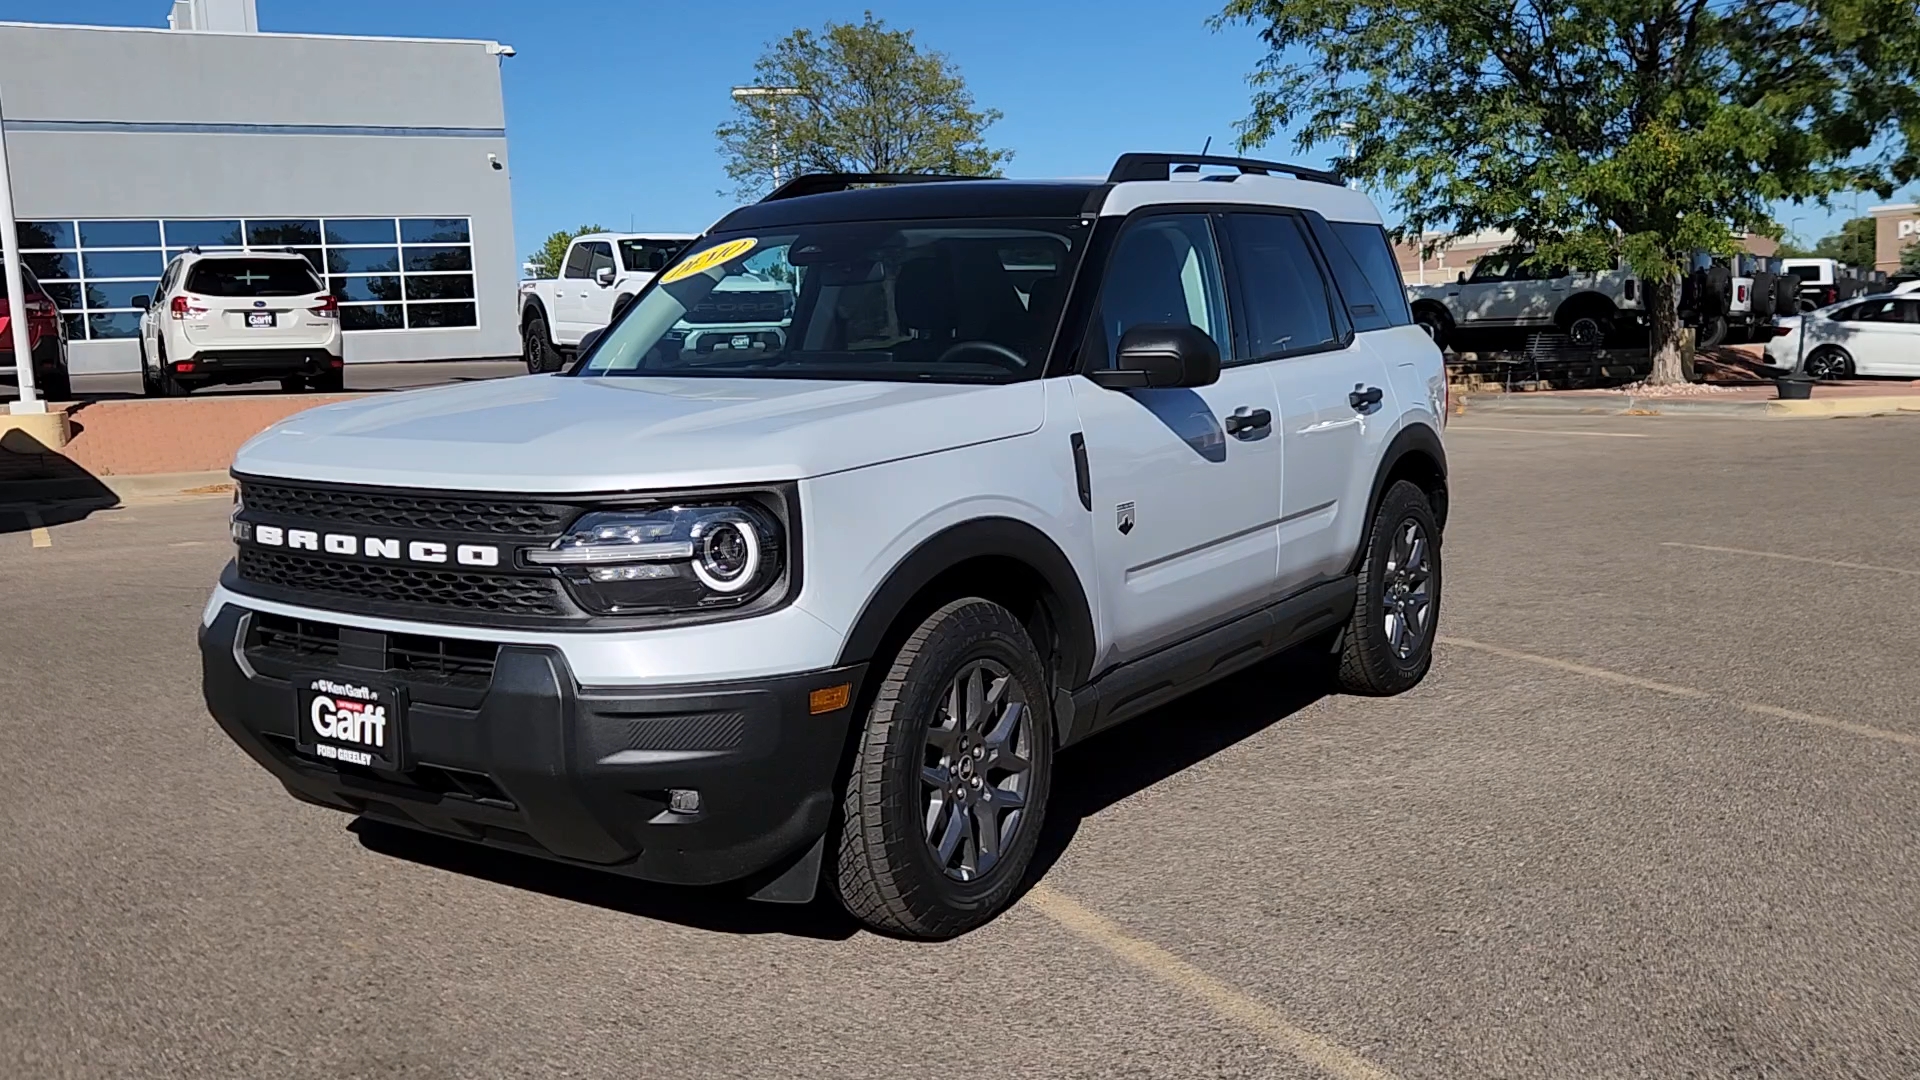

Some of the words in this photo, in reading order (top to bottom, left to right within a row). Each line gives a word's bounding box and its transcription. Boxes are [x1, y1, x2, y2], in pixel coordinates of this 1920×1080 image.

[256, 525, 499, 566] BRONCO
[311, 695, 386, 748] Garff
[317, 743, 337, 759] FORD
